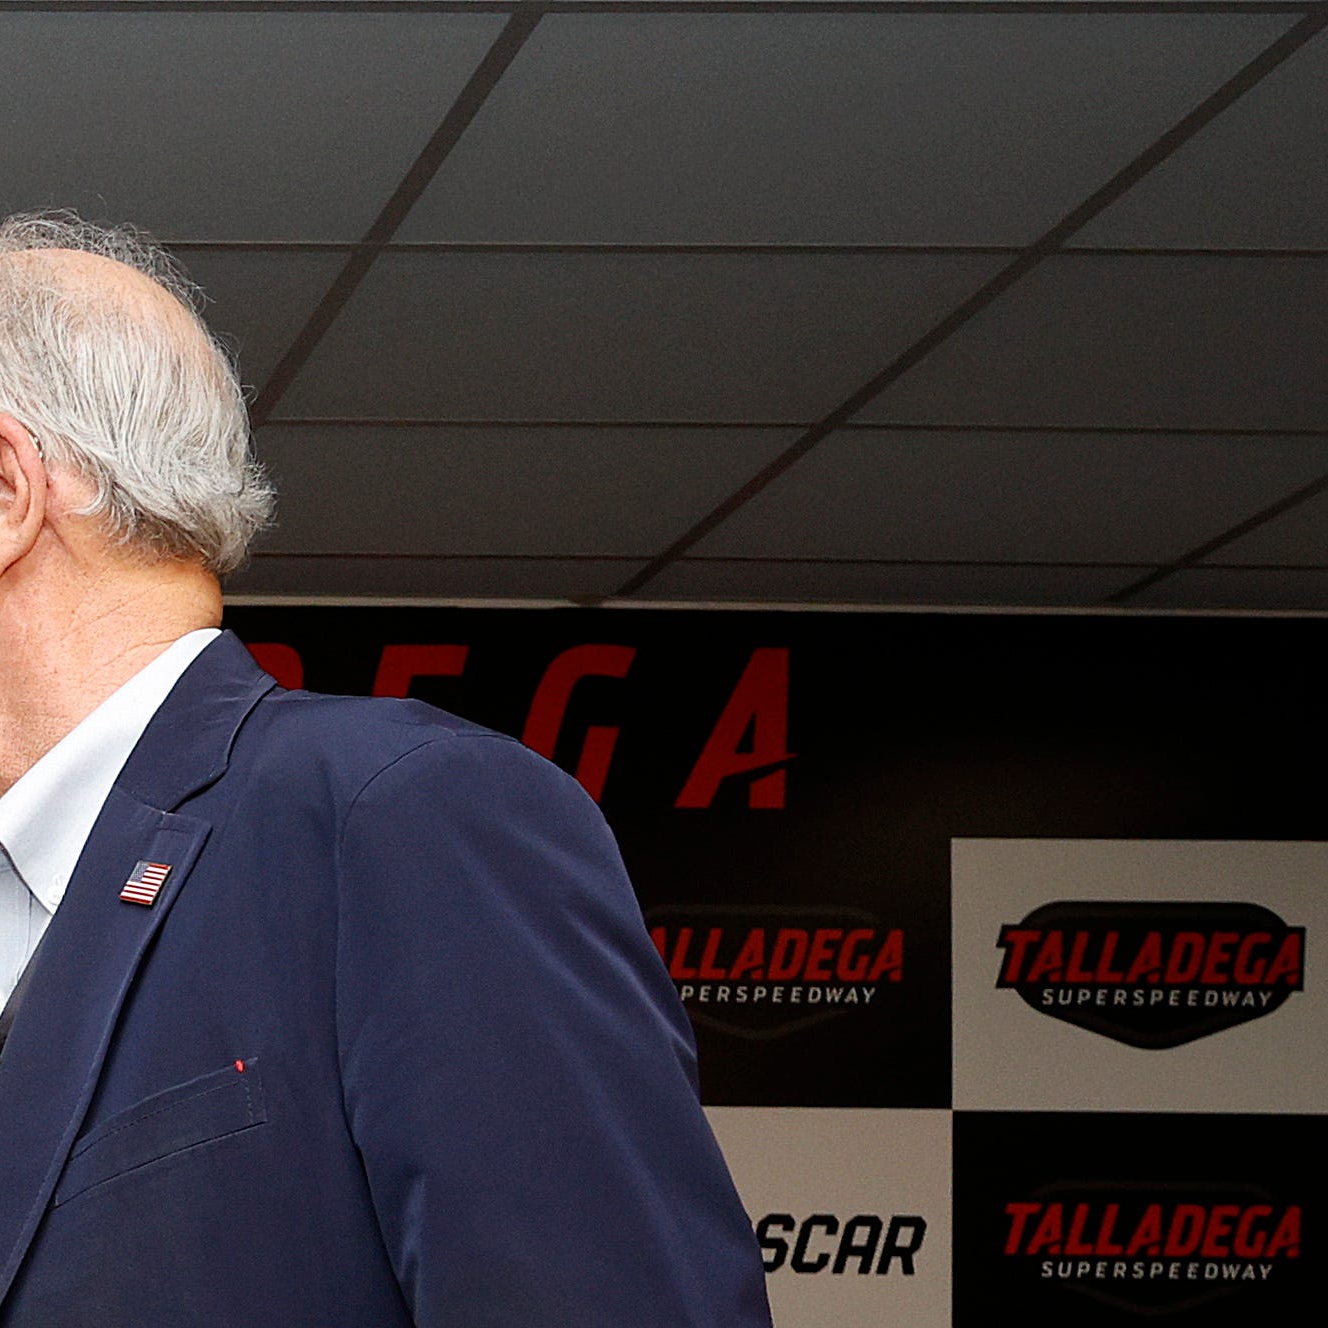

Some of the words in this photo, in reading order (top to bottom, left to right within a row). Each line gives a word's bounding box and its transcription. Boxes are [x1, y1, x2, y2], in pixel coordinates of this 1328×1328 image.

[1004, 930, 1301, 985] TALLADEGA
[1041, 988, 1272, 1008] SUPERSPEEDWAY
[1004, 1203, 1302, 1258] TALLADEGA
[1041, 1260, 1273, 1280] SUPERSPEEDWAY
